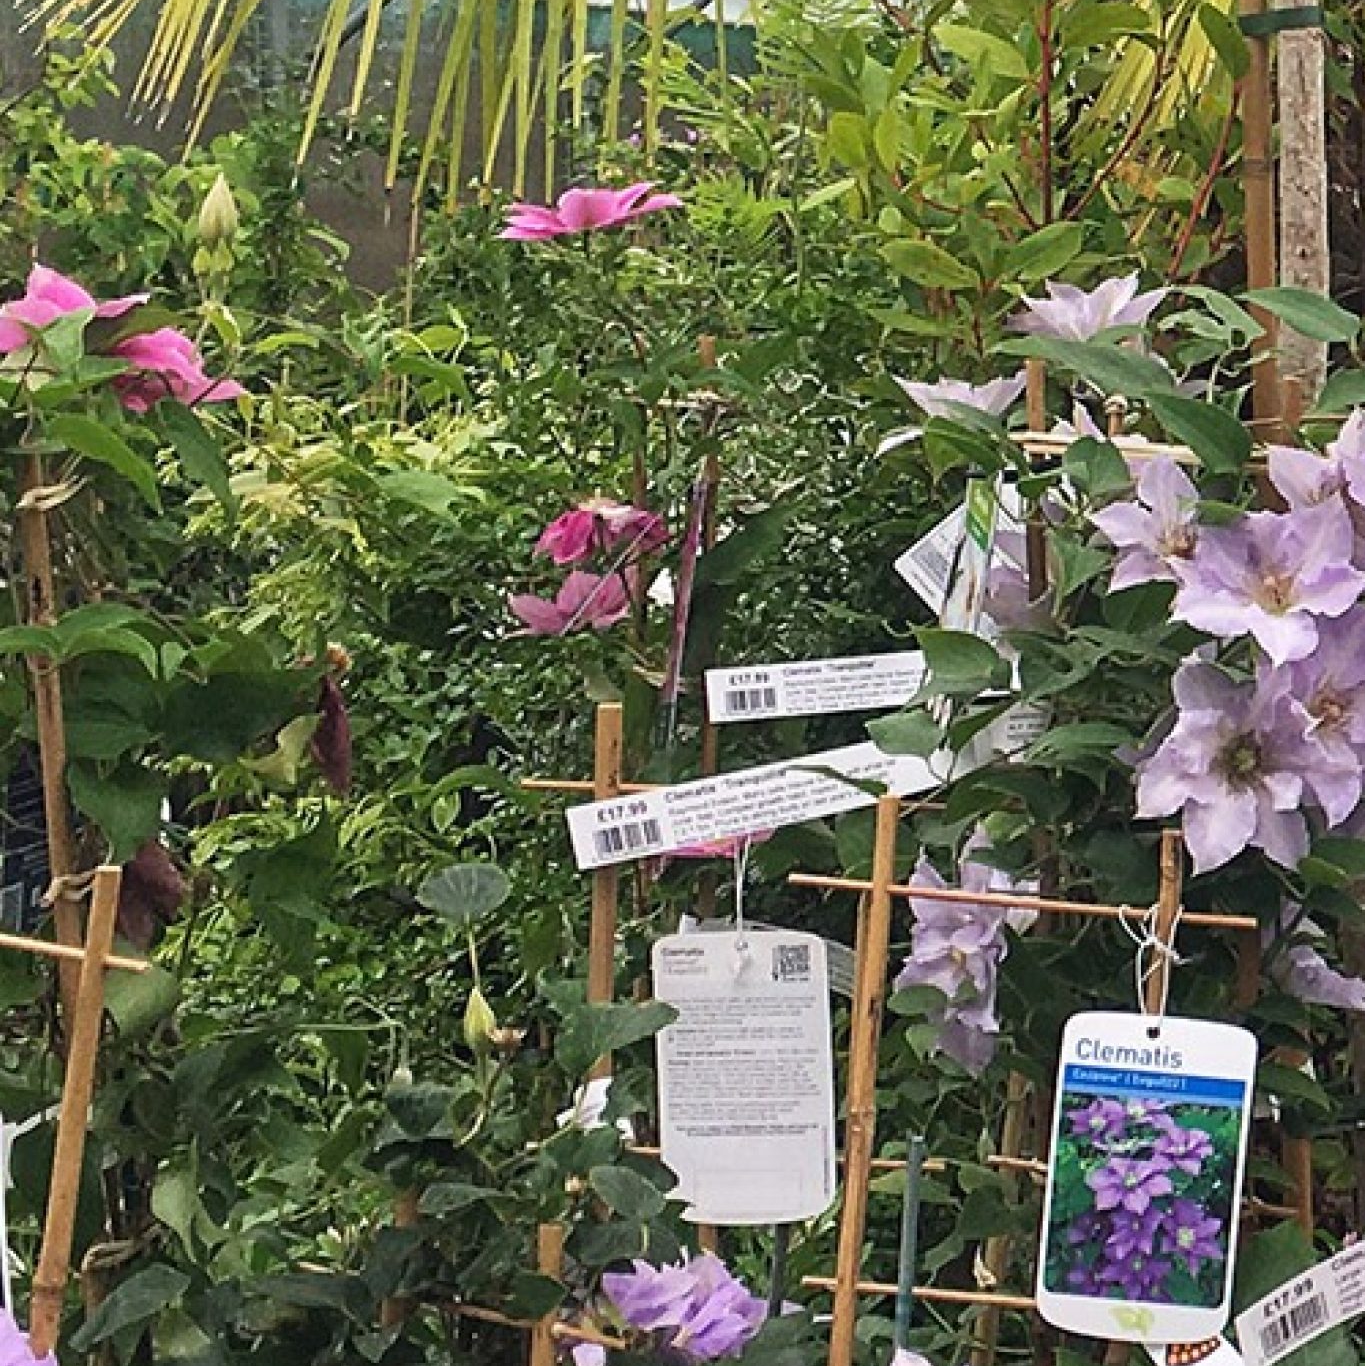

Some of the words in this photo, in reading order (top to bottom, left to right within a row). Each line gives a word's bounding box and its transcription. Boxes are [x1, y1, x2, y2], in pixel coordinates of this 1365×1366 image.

[663, 781, 717, 804] Clematis
[596, 799, 649, 825] £17.99
[1075, 1036, 1184, 1072] Clematis
[1261, 1277, 1316, 1319] £17.99
